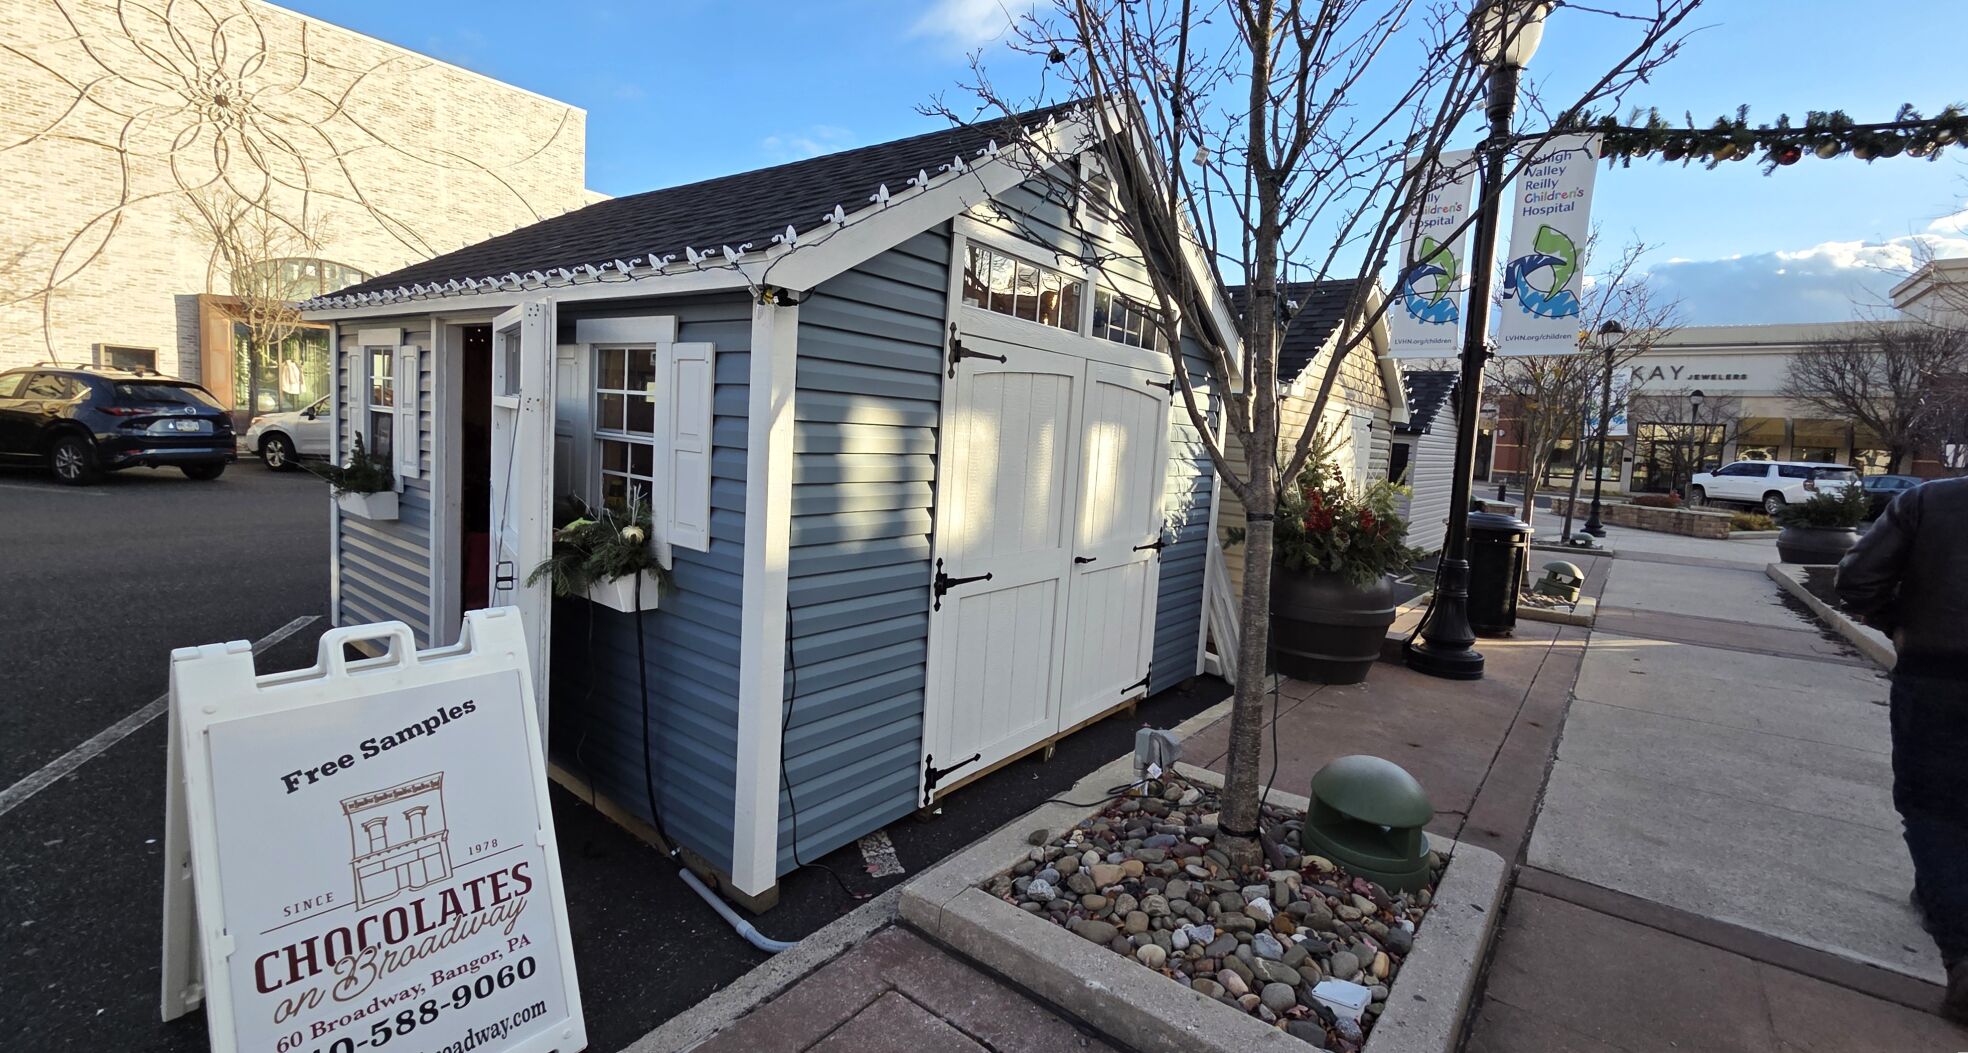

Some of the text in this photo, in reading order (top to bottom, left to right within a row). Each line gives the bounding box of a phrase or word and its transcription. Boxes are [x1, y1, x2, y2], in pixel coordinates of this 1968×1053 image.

[1527, 165, 1567, 178] Valley
[1525, 178, 1559, 191] Reilly
[1524, 186, 1584, 204] Children's
[1410, 201, 1463, 216] Cildren's
[1522, 201, 1575, 217] Hospital
[1394, 337, 1452, 346] LVHN.org/children
[1505, 333, 1572, 342] LVHN.org/children
[1631, 365, 1685, 381] KAY
[281, 699, 476, 795] Free Samples
[283, 839, 499, 917] SINCE 1978
[254, 861, 533, 994] CHOCOLATES
[273, 897, 527, 1024] on Broadway
[276, 933, 532, 1053] 60 Broadway, Bangor, PA
[313, 955, 537, 1053] 0-588-9060
